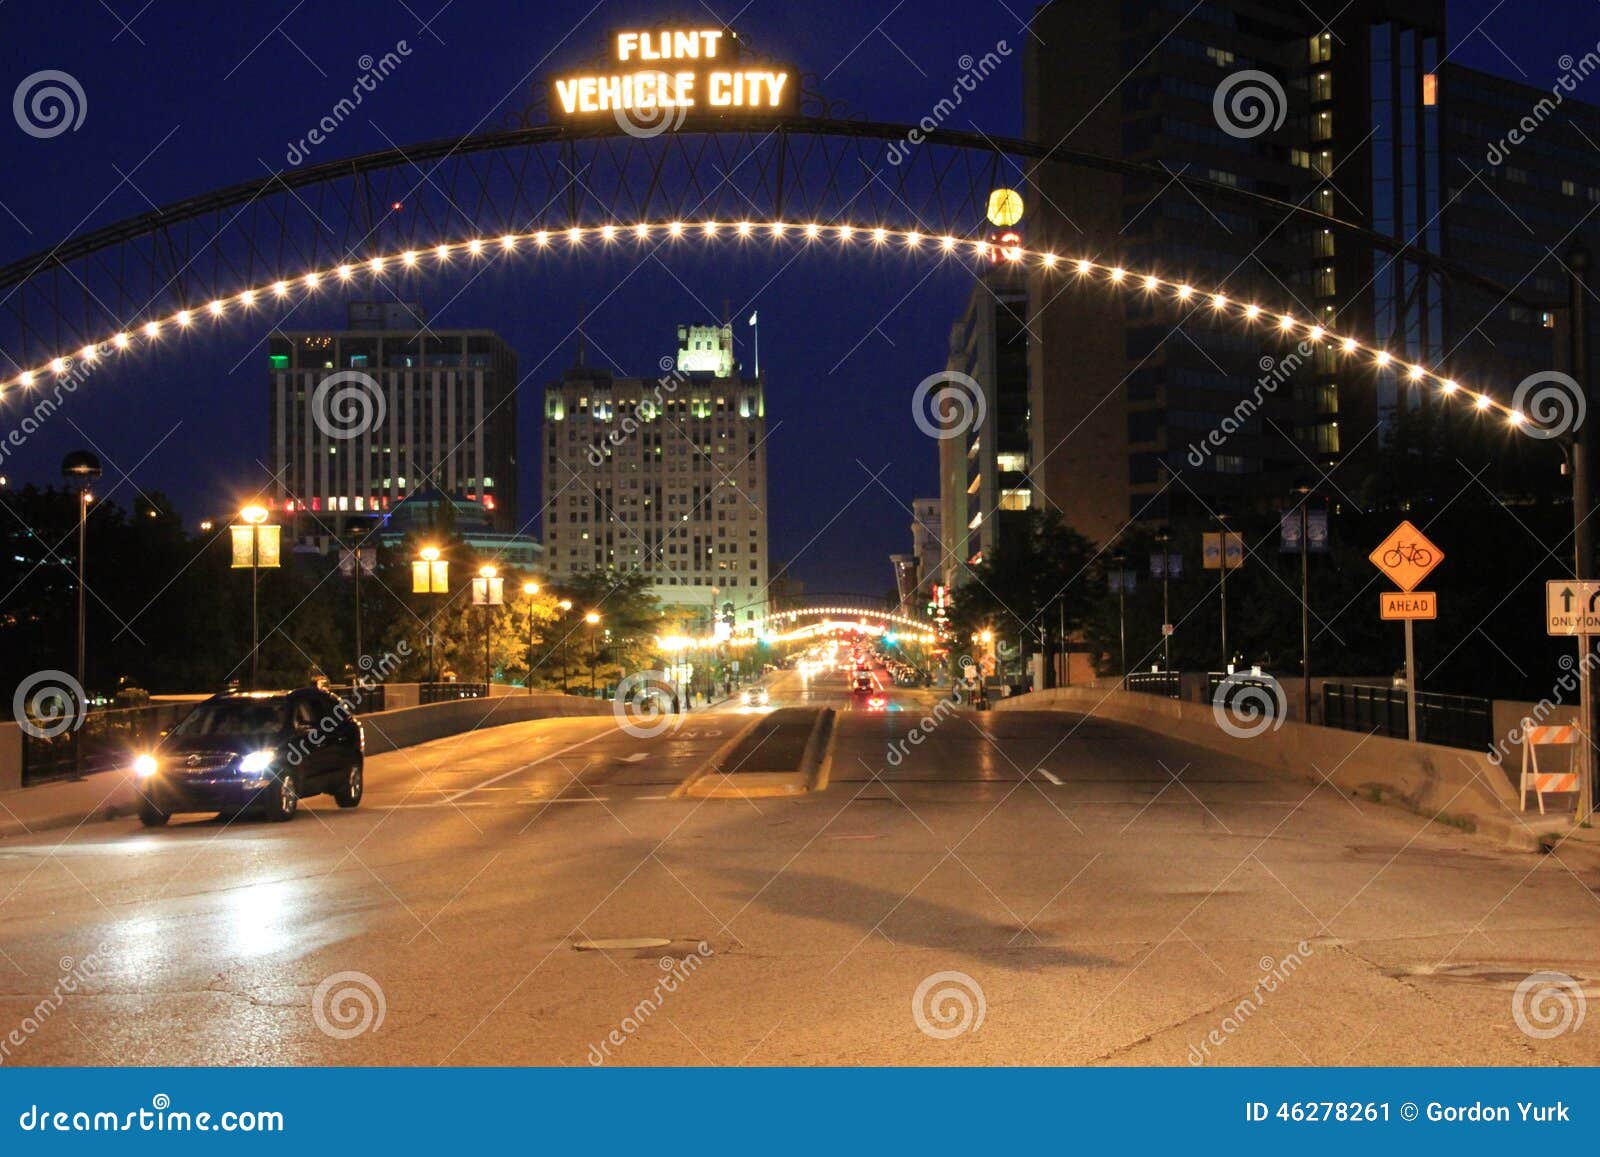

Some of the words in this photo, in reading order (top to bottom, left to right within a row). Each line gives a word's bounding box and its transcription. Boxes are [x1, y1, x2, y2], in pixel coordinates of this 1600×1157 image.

[617, 31, 722, 60] FLINT
[556, 72, 695, 113] VEHICLE
[709, 72, 787, 106] CITY
[1388, 600, 1428, 613] AHEAD
[1552, 616, 1582, 627] ONLY
